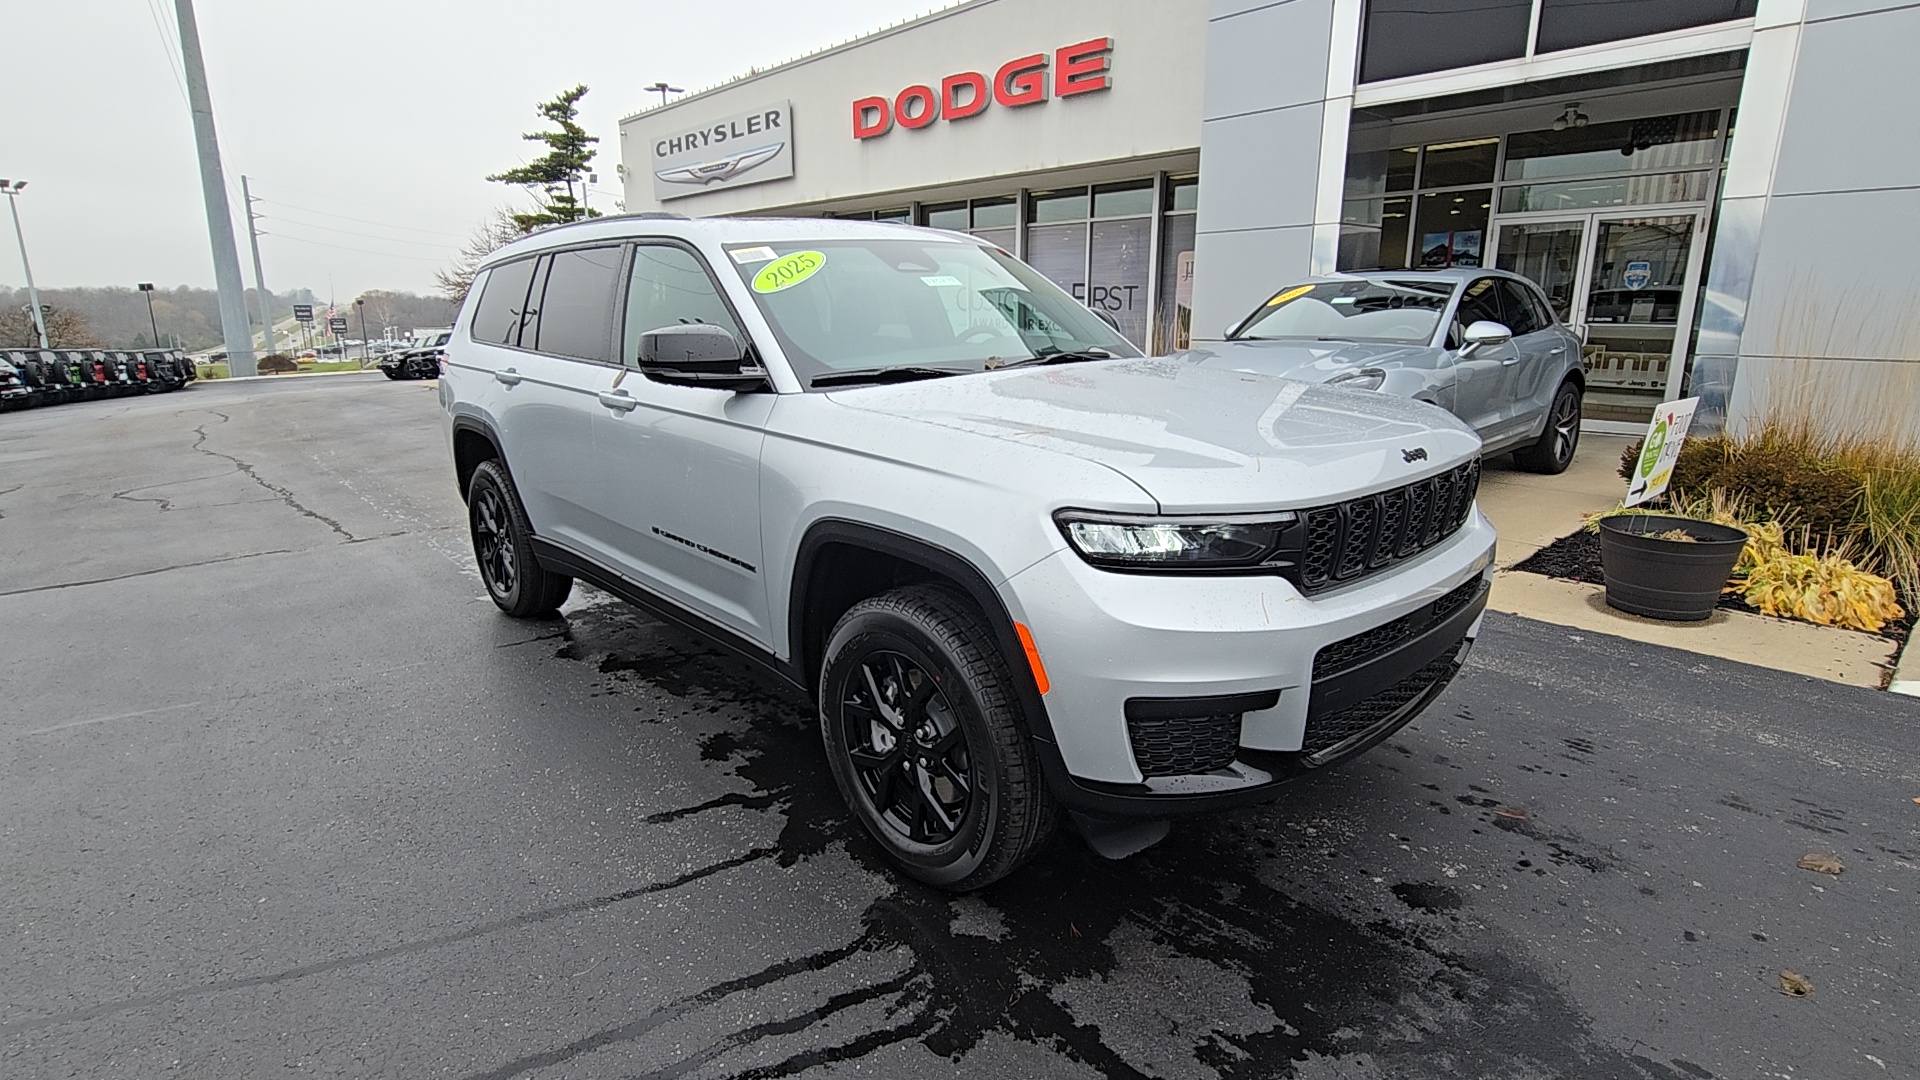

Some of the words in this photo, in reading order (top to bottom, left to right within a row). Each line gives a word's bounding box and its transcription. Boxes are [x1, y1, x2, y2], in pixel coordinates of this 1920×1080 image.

[853, 37, 1113, 139] DODGE
[655, 110, 781, 157] CHRYSLER
[765, 254, 816, 288] 2025
